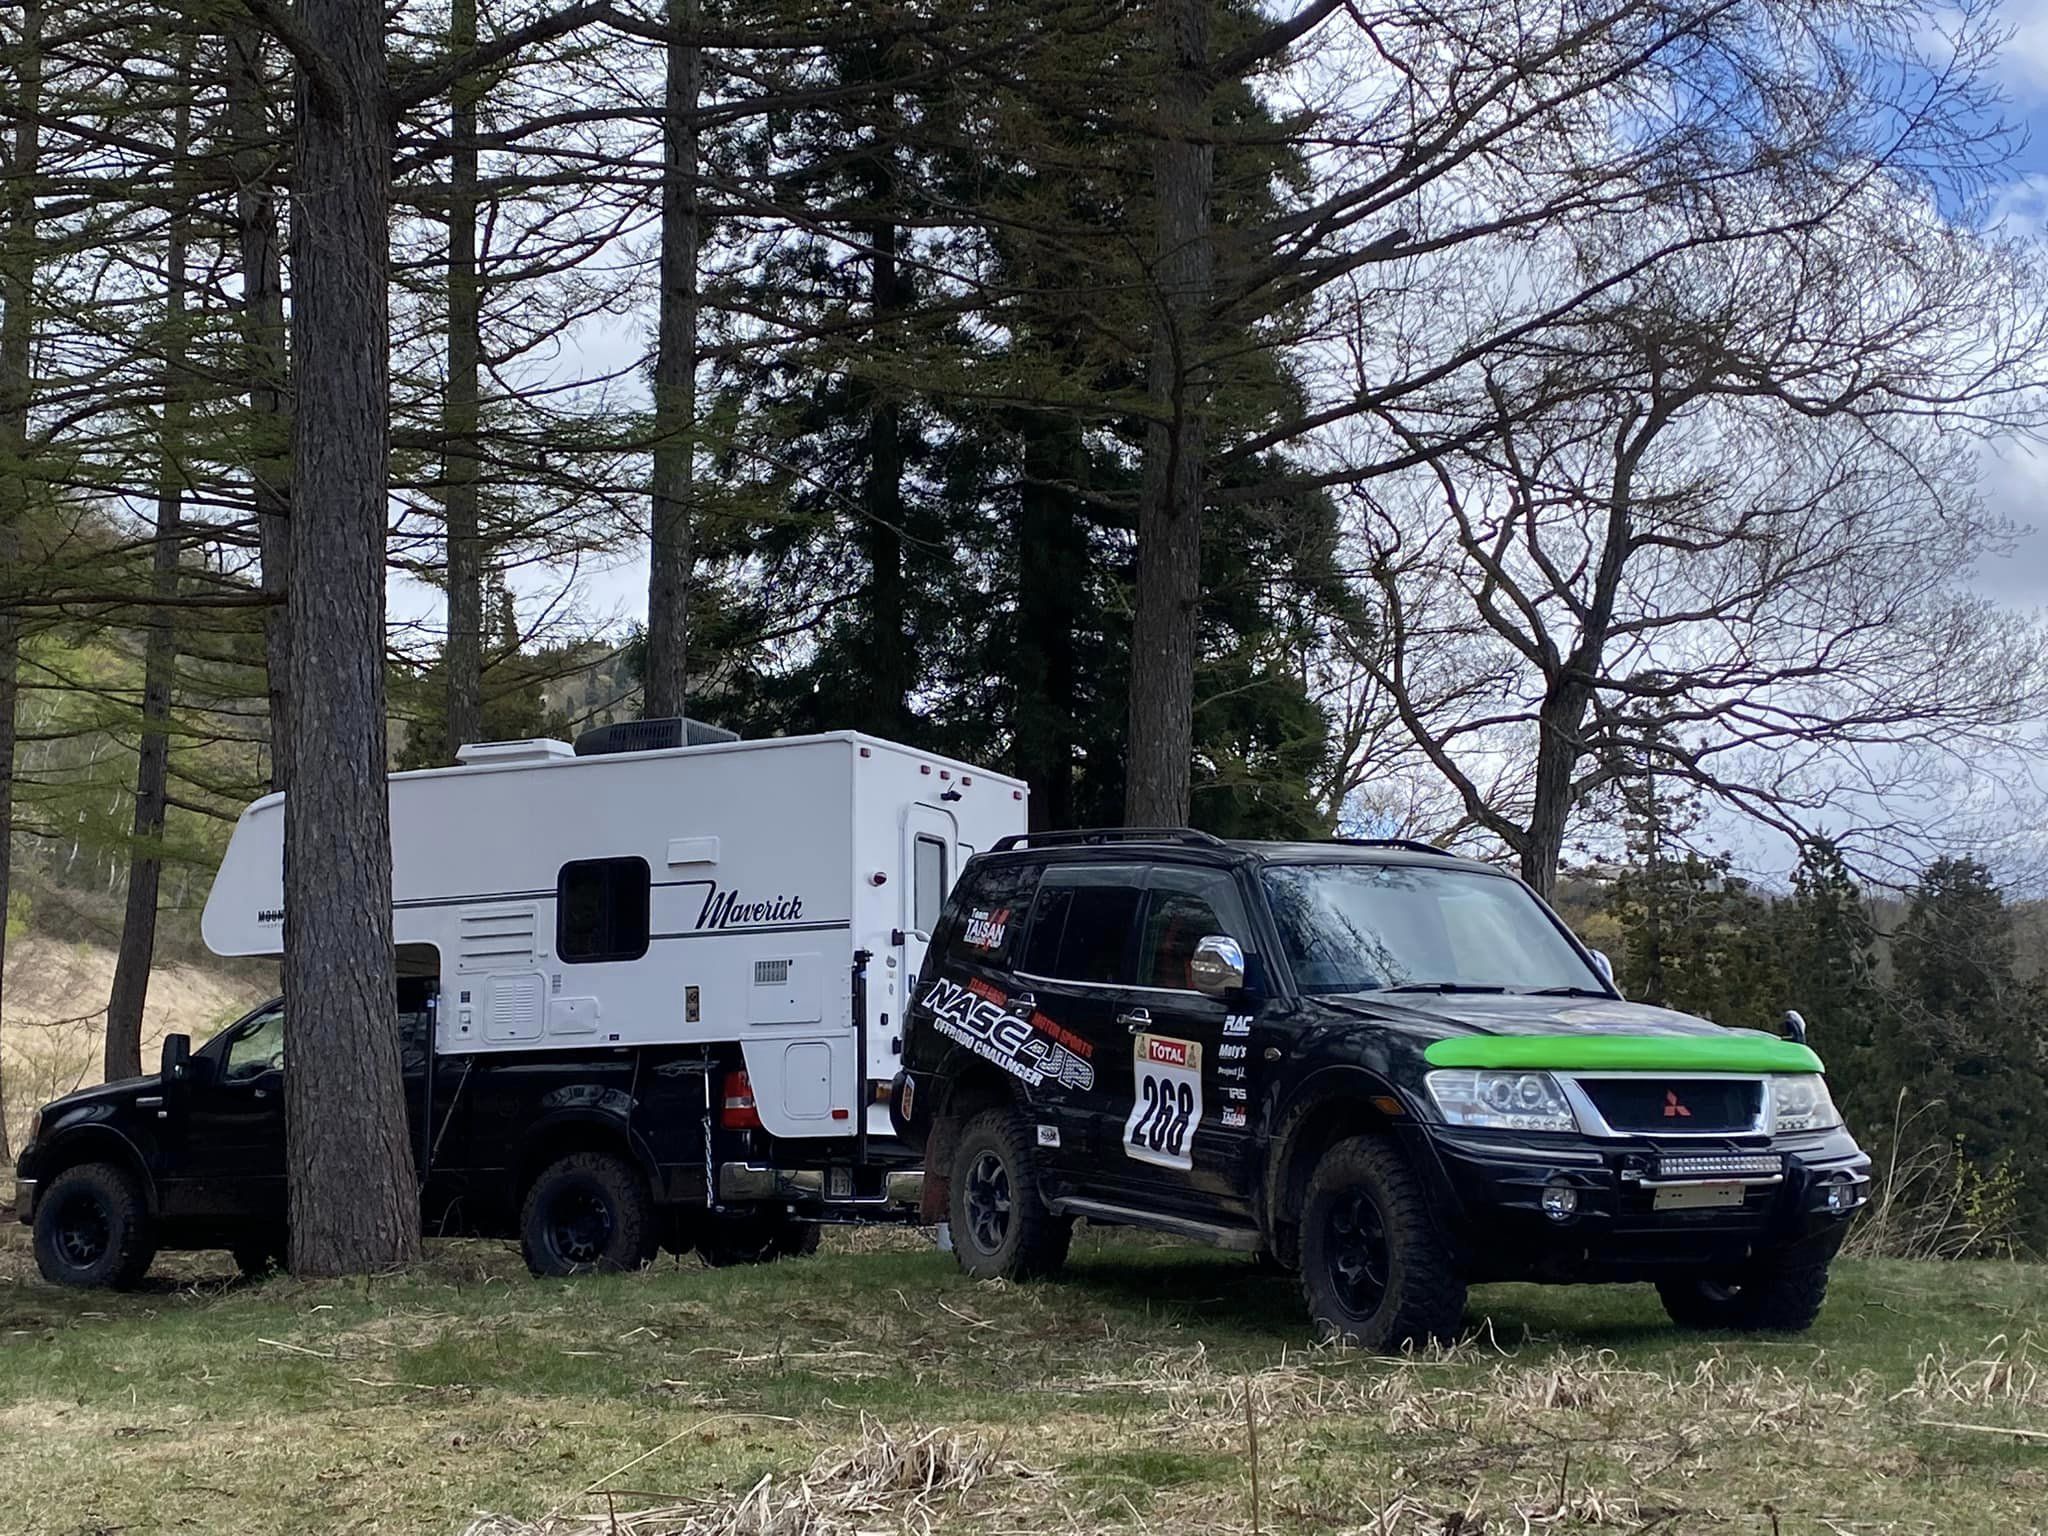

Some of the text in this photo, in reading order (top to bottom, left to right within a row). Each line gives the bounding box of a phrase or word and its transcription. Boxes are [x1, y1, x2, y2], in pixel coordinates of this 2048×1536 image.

[695, 889, 803, 929] Maverick
[966, 918, 1006, 943] TAISAN
[1131, 1075, 1194, 1156] 268
